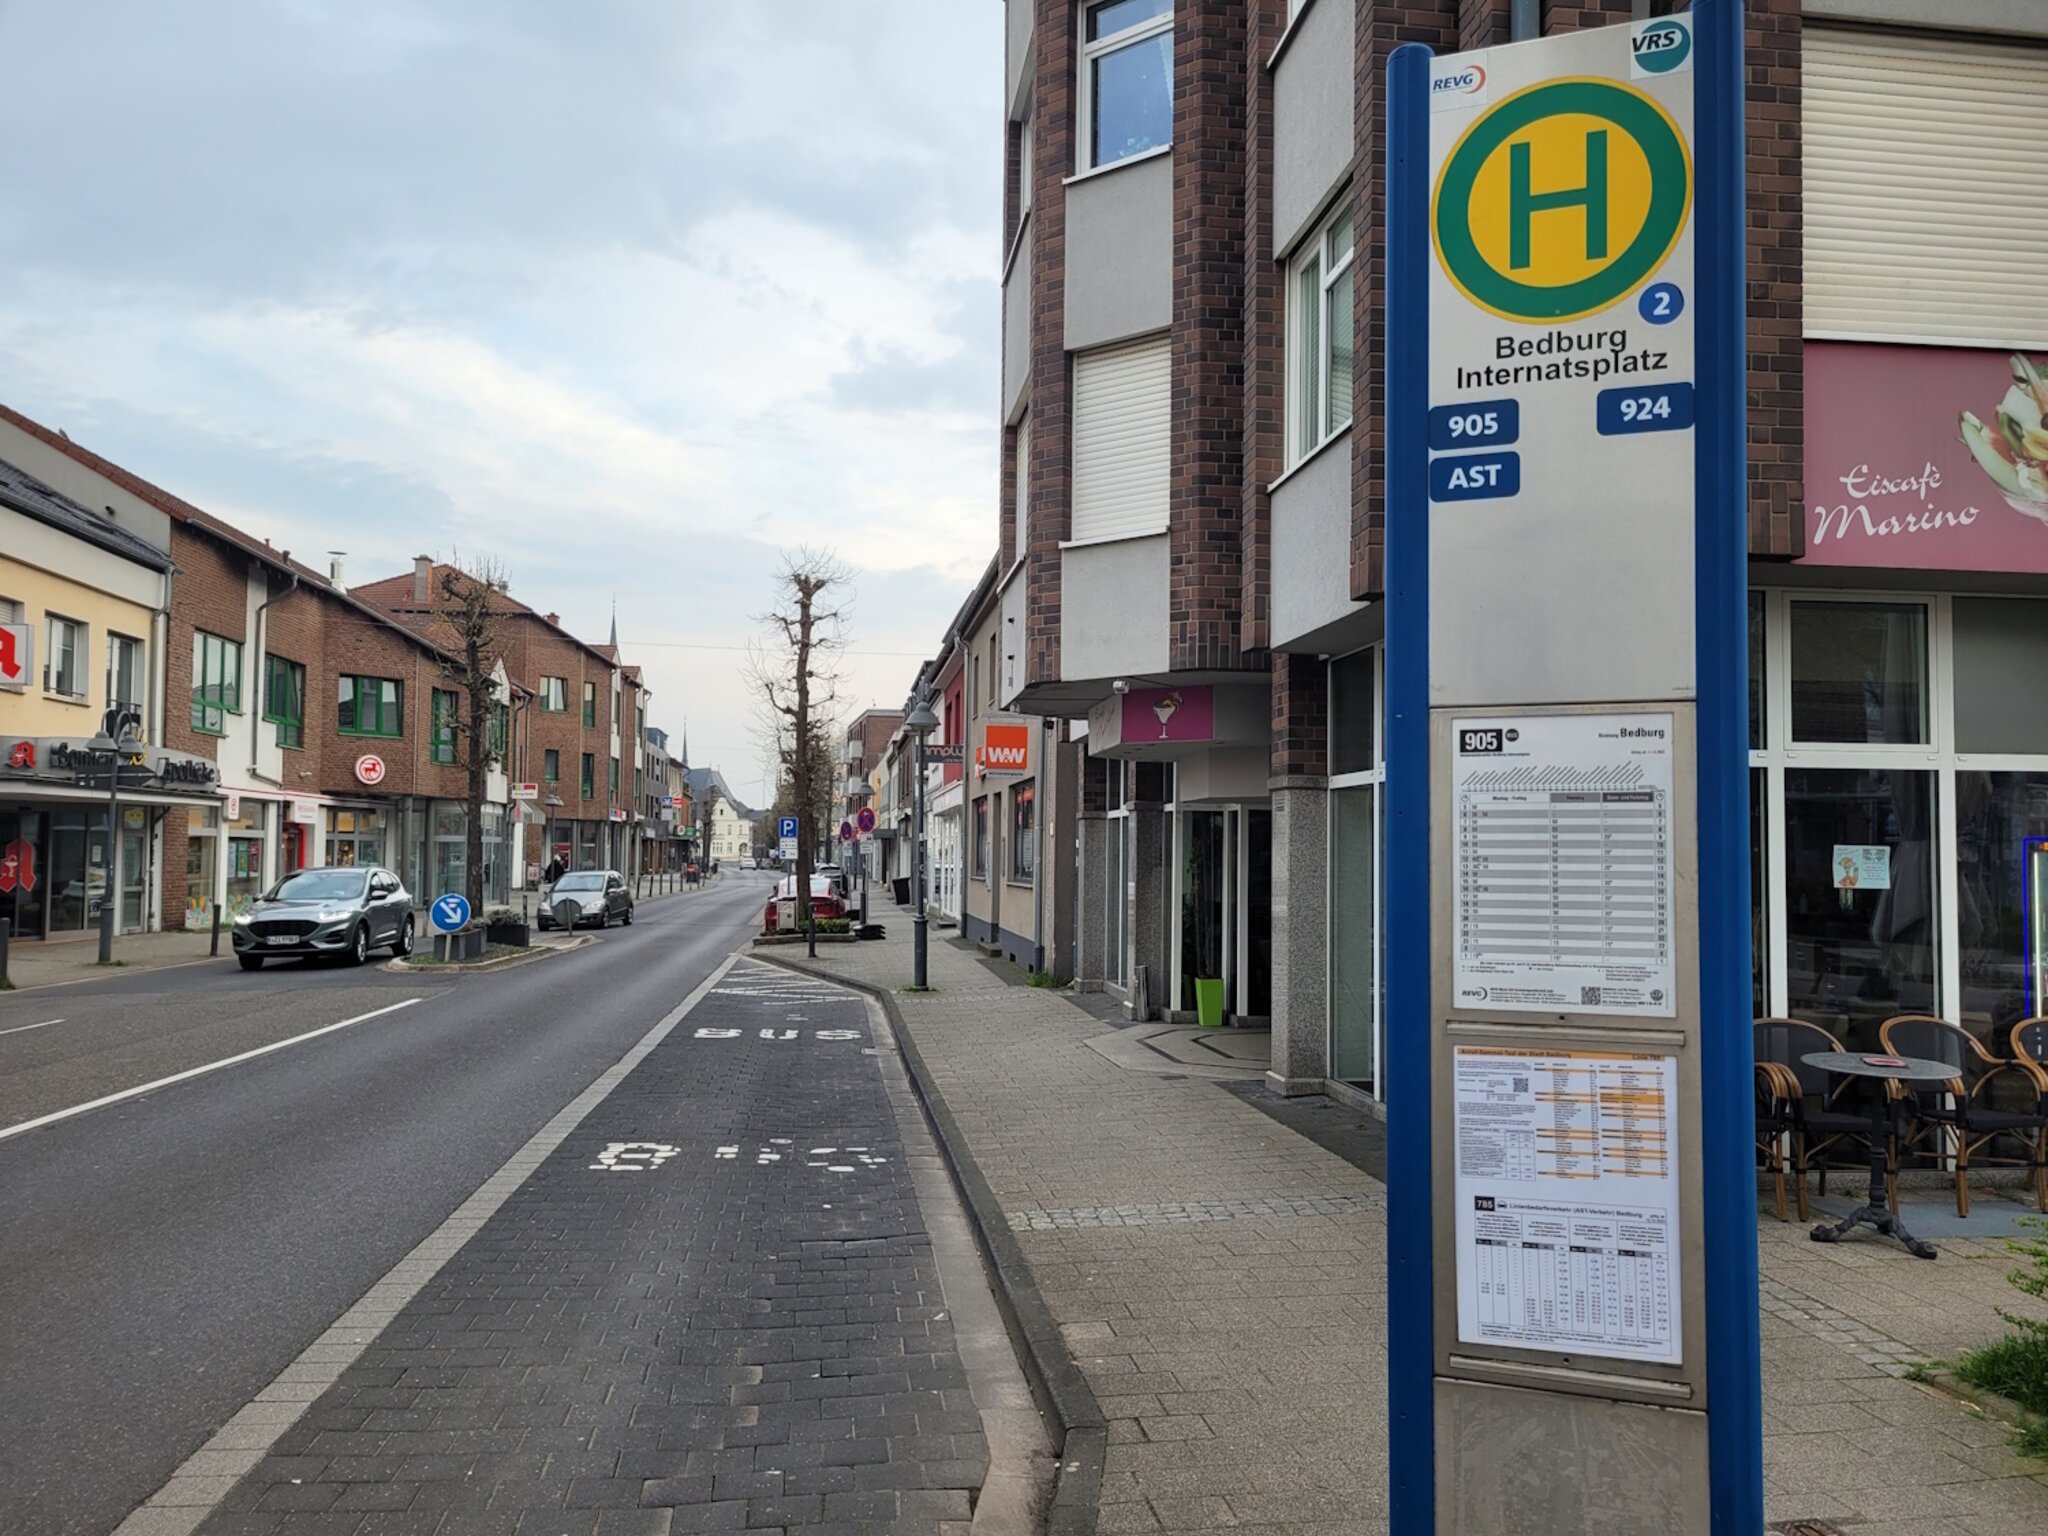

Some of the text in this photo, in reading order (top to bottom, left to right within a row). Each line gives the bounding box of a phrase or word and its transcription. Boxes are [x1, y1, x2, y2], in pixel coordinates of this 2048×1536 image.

[1632, 30, 1676, 53] VRS
[1432, 73, 1474, 91] REVG
[1510, 129, 1608, 271] H
[1652, 292, 1670, 316] 2
[1496, 330, 1627, 360] Bedburg
[1457, 350, 1668, 389] Internatsplatz
[1620, 396, 1671, 422] 924
[1448, 413, 1498, 438] 905
[1448, 464, 1502, 490] AST
[1814, 503, 1980, 545] Marino
[1465, 732, 1498, 751] 905
[1620, 728, 1664, 740] Bedburg
[784, 820, 794, 836] P
[1476, 1200, 1493, 1209] 785
